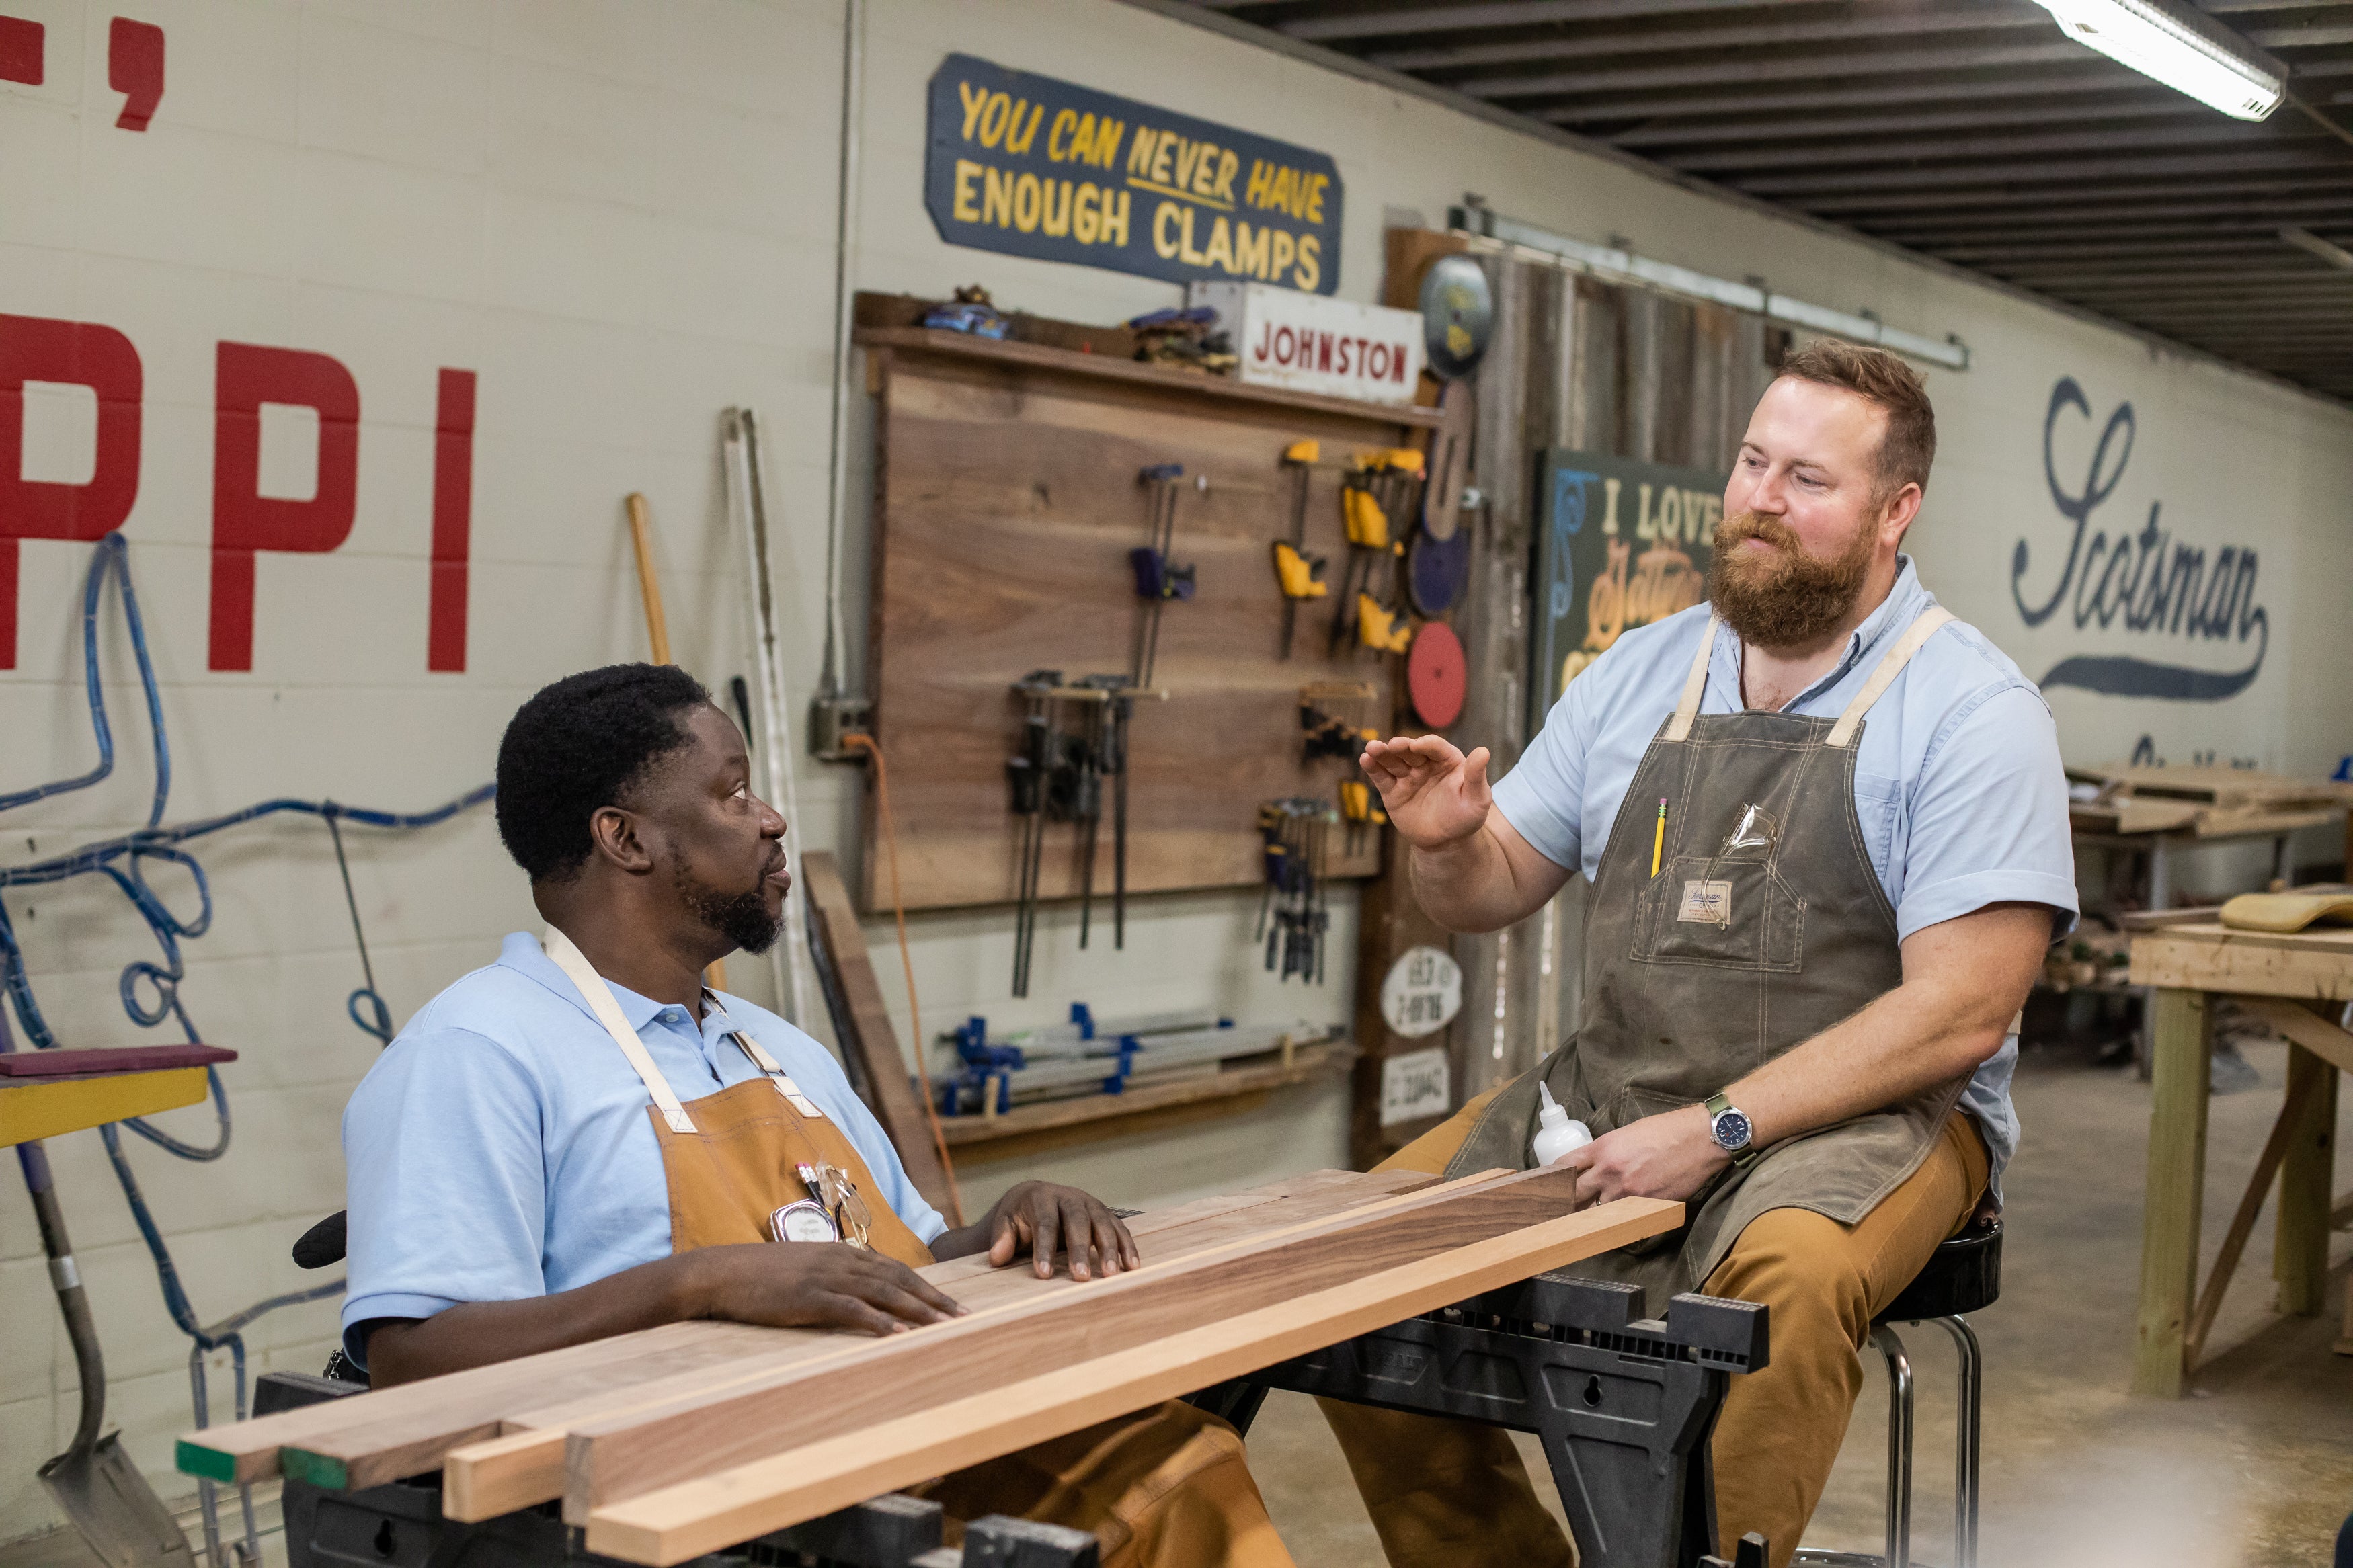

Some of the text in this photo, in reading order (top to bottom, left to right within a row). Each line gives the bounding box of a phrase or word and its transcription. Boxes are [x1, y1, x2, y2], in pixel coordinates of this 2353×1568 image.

[959, 81, 1330, 224] YOU CAN NEVER HAVE
[953, 159, 1322, 292] ENOUGH CLAMPS
[1254, 321, 1408, 384] JOHNSTON
[1601, 478, 1724, 546] I LOVE
[2011, 376, 2268, 645] Scotsman
